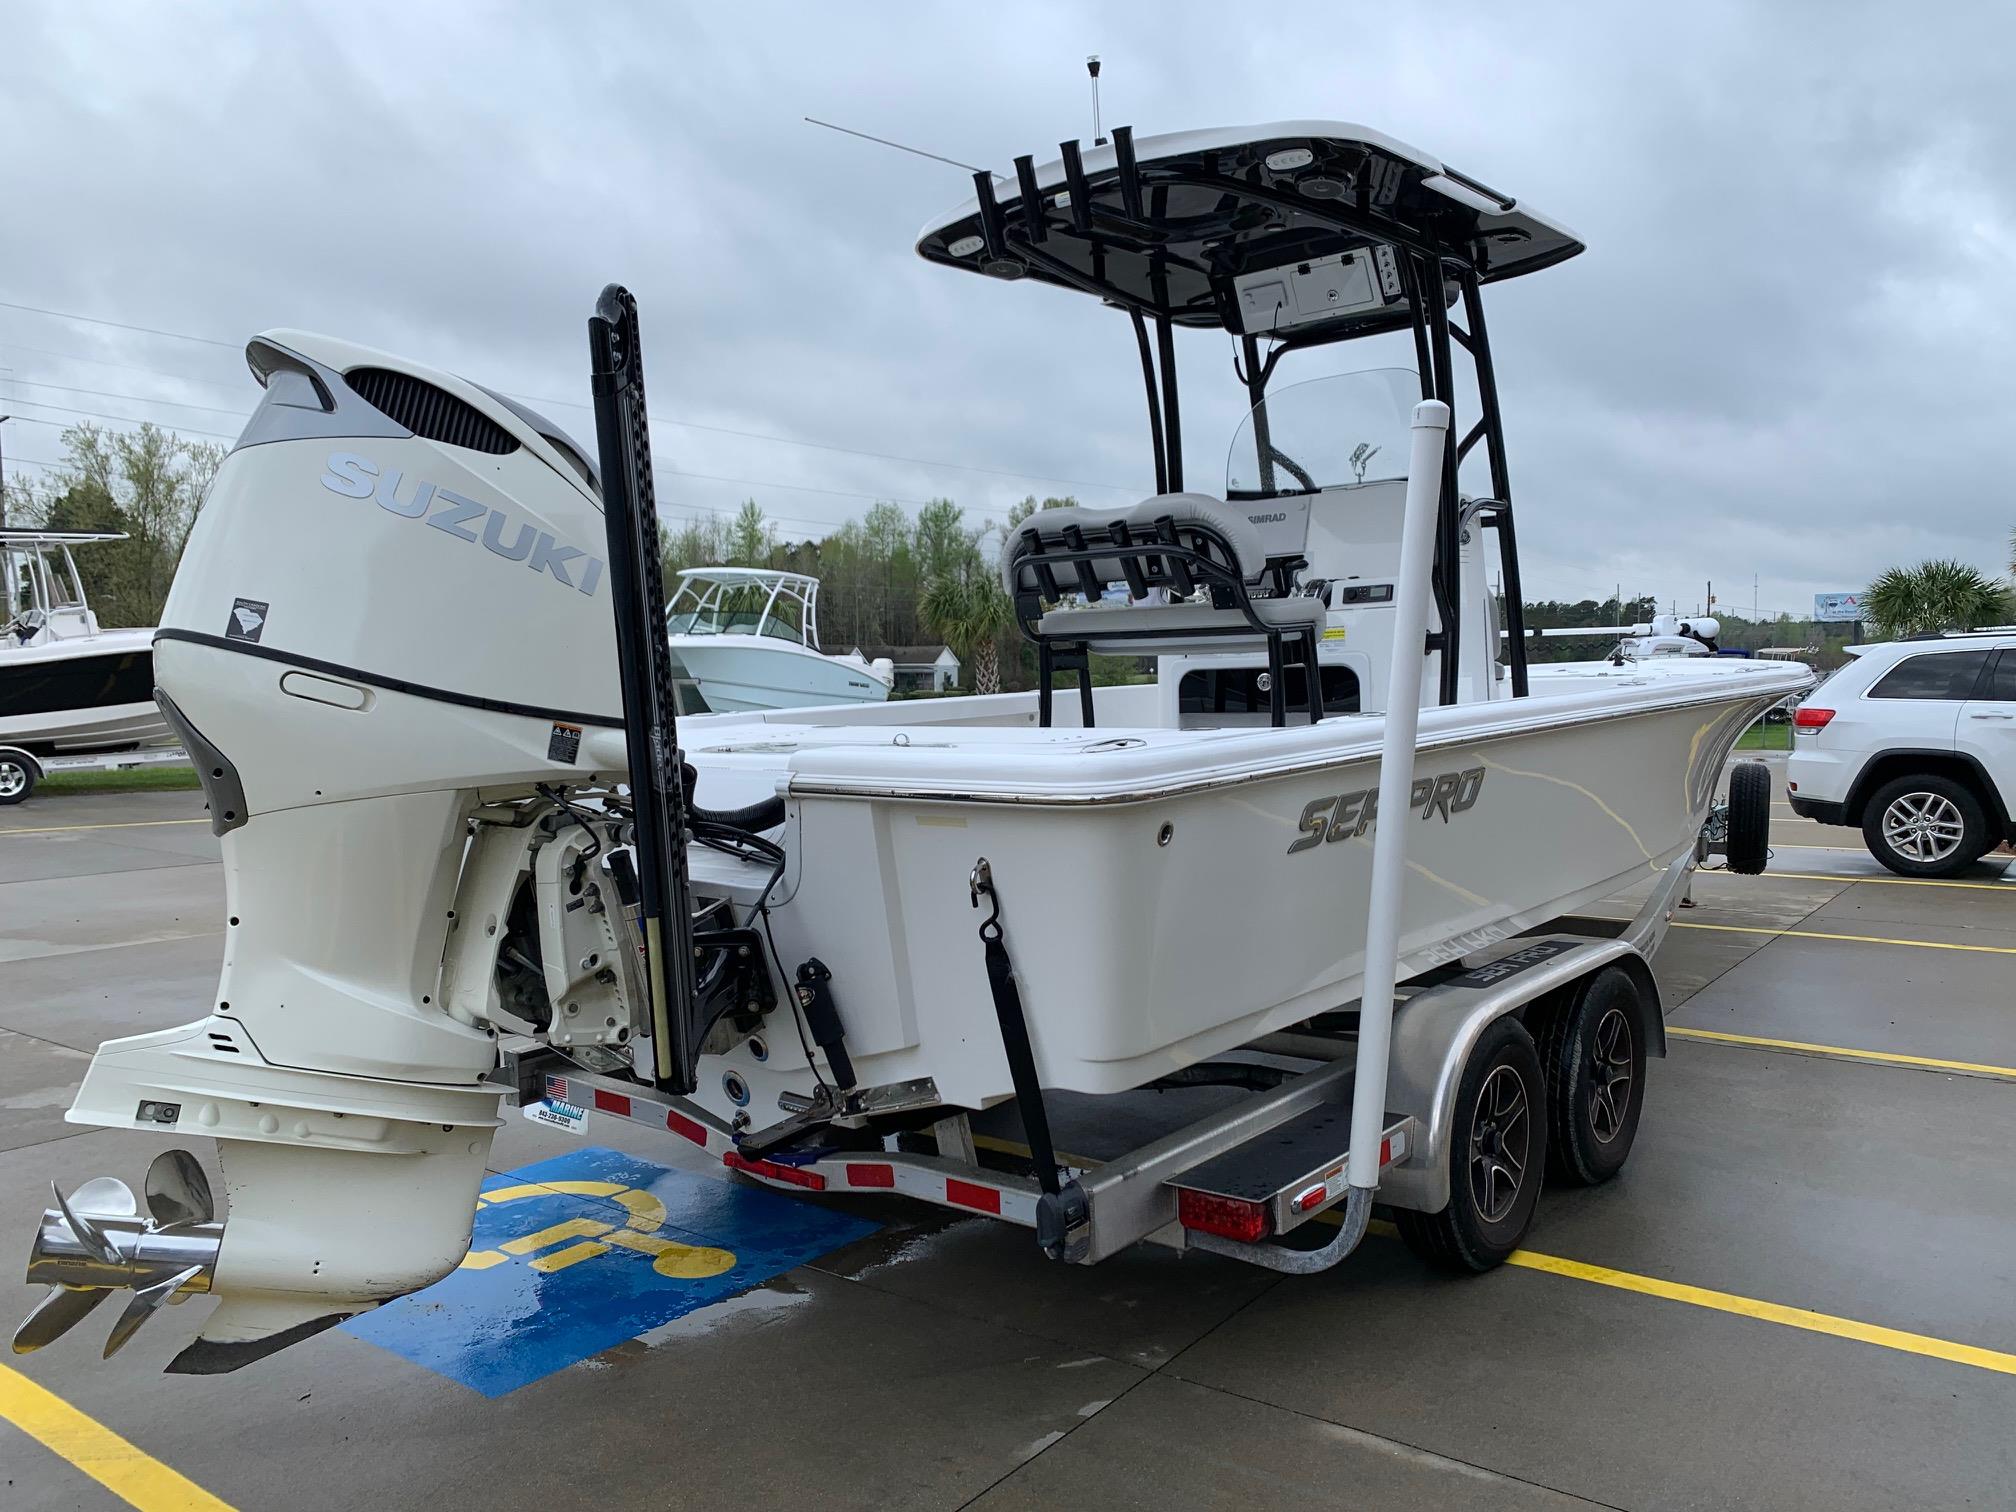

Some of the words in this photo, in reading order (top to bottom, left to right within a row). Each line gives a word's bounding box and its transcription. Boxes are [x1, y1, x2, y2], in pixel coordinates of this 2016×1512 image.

[319, 451, 604, 597] SUZUKI
[1464, 961, 1521, 982] SEA
[550, 1099, 585, 1121] MARINE
